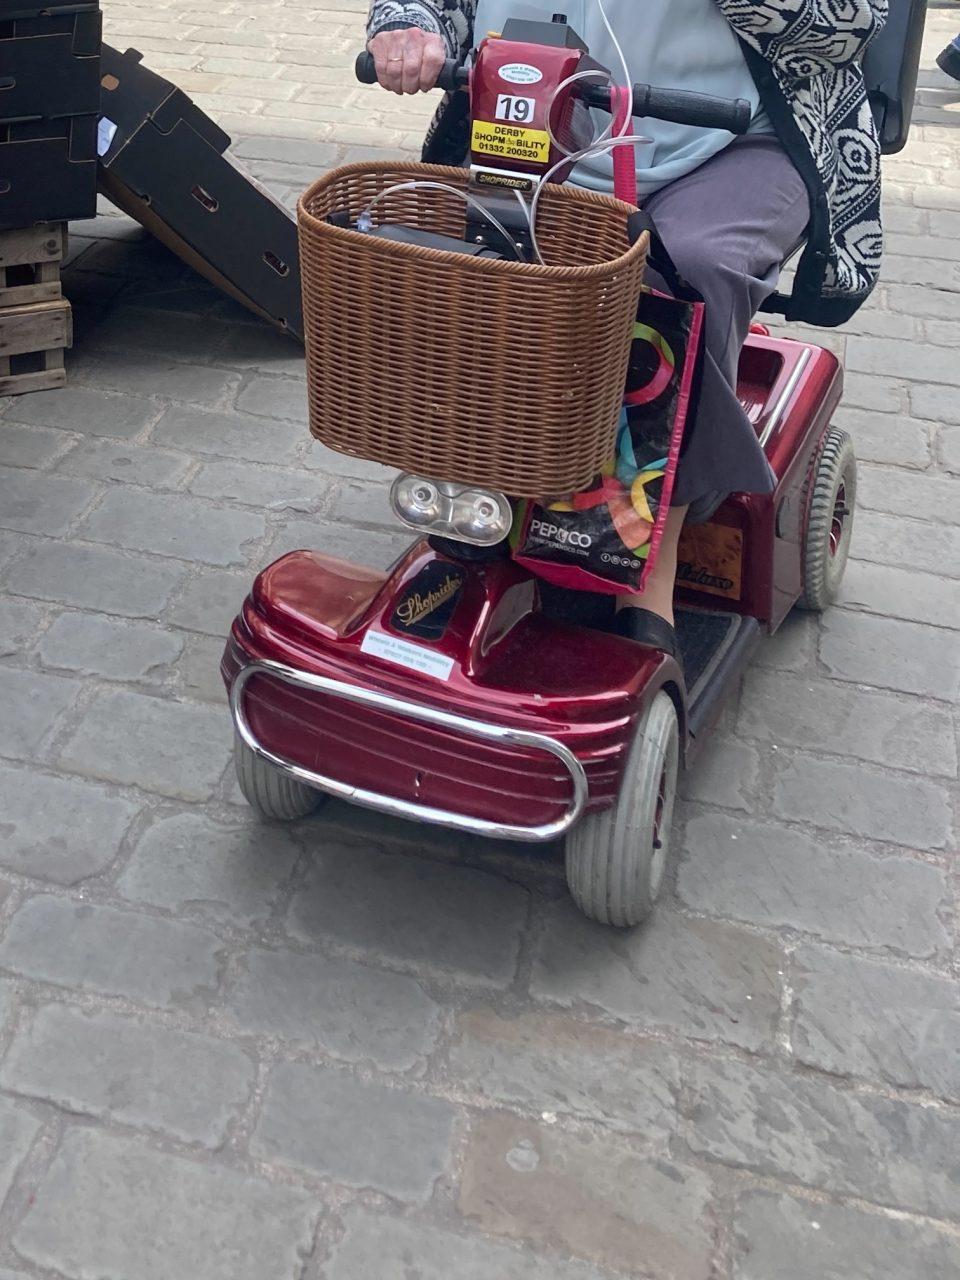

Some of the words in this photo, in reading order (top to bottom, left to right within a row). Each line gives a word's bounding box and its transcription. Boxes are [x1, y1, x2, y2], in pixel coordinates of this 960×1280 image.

[500, 97, 530, 121] 19
[494, 126, 525, 138] DERBY
[478, 142, 504, 152] 01332
[506, 146, 538, 159] 200320
[480, 174, 528, 188] SHOPRIDER
